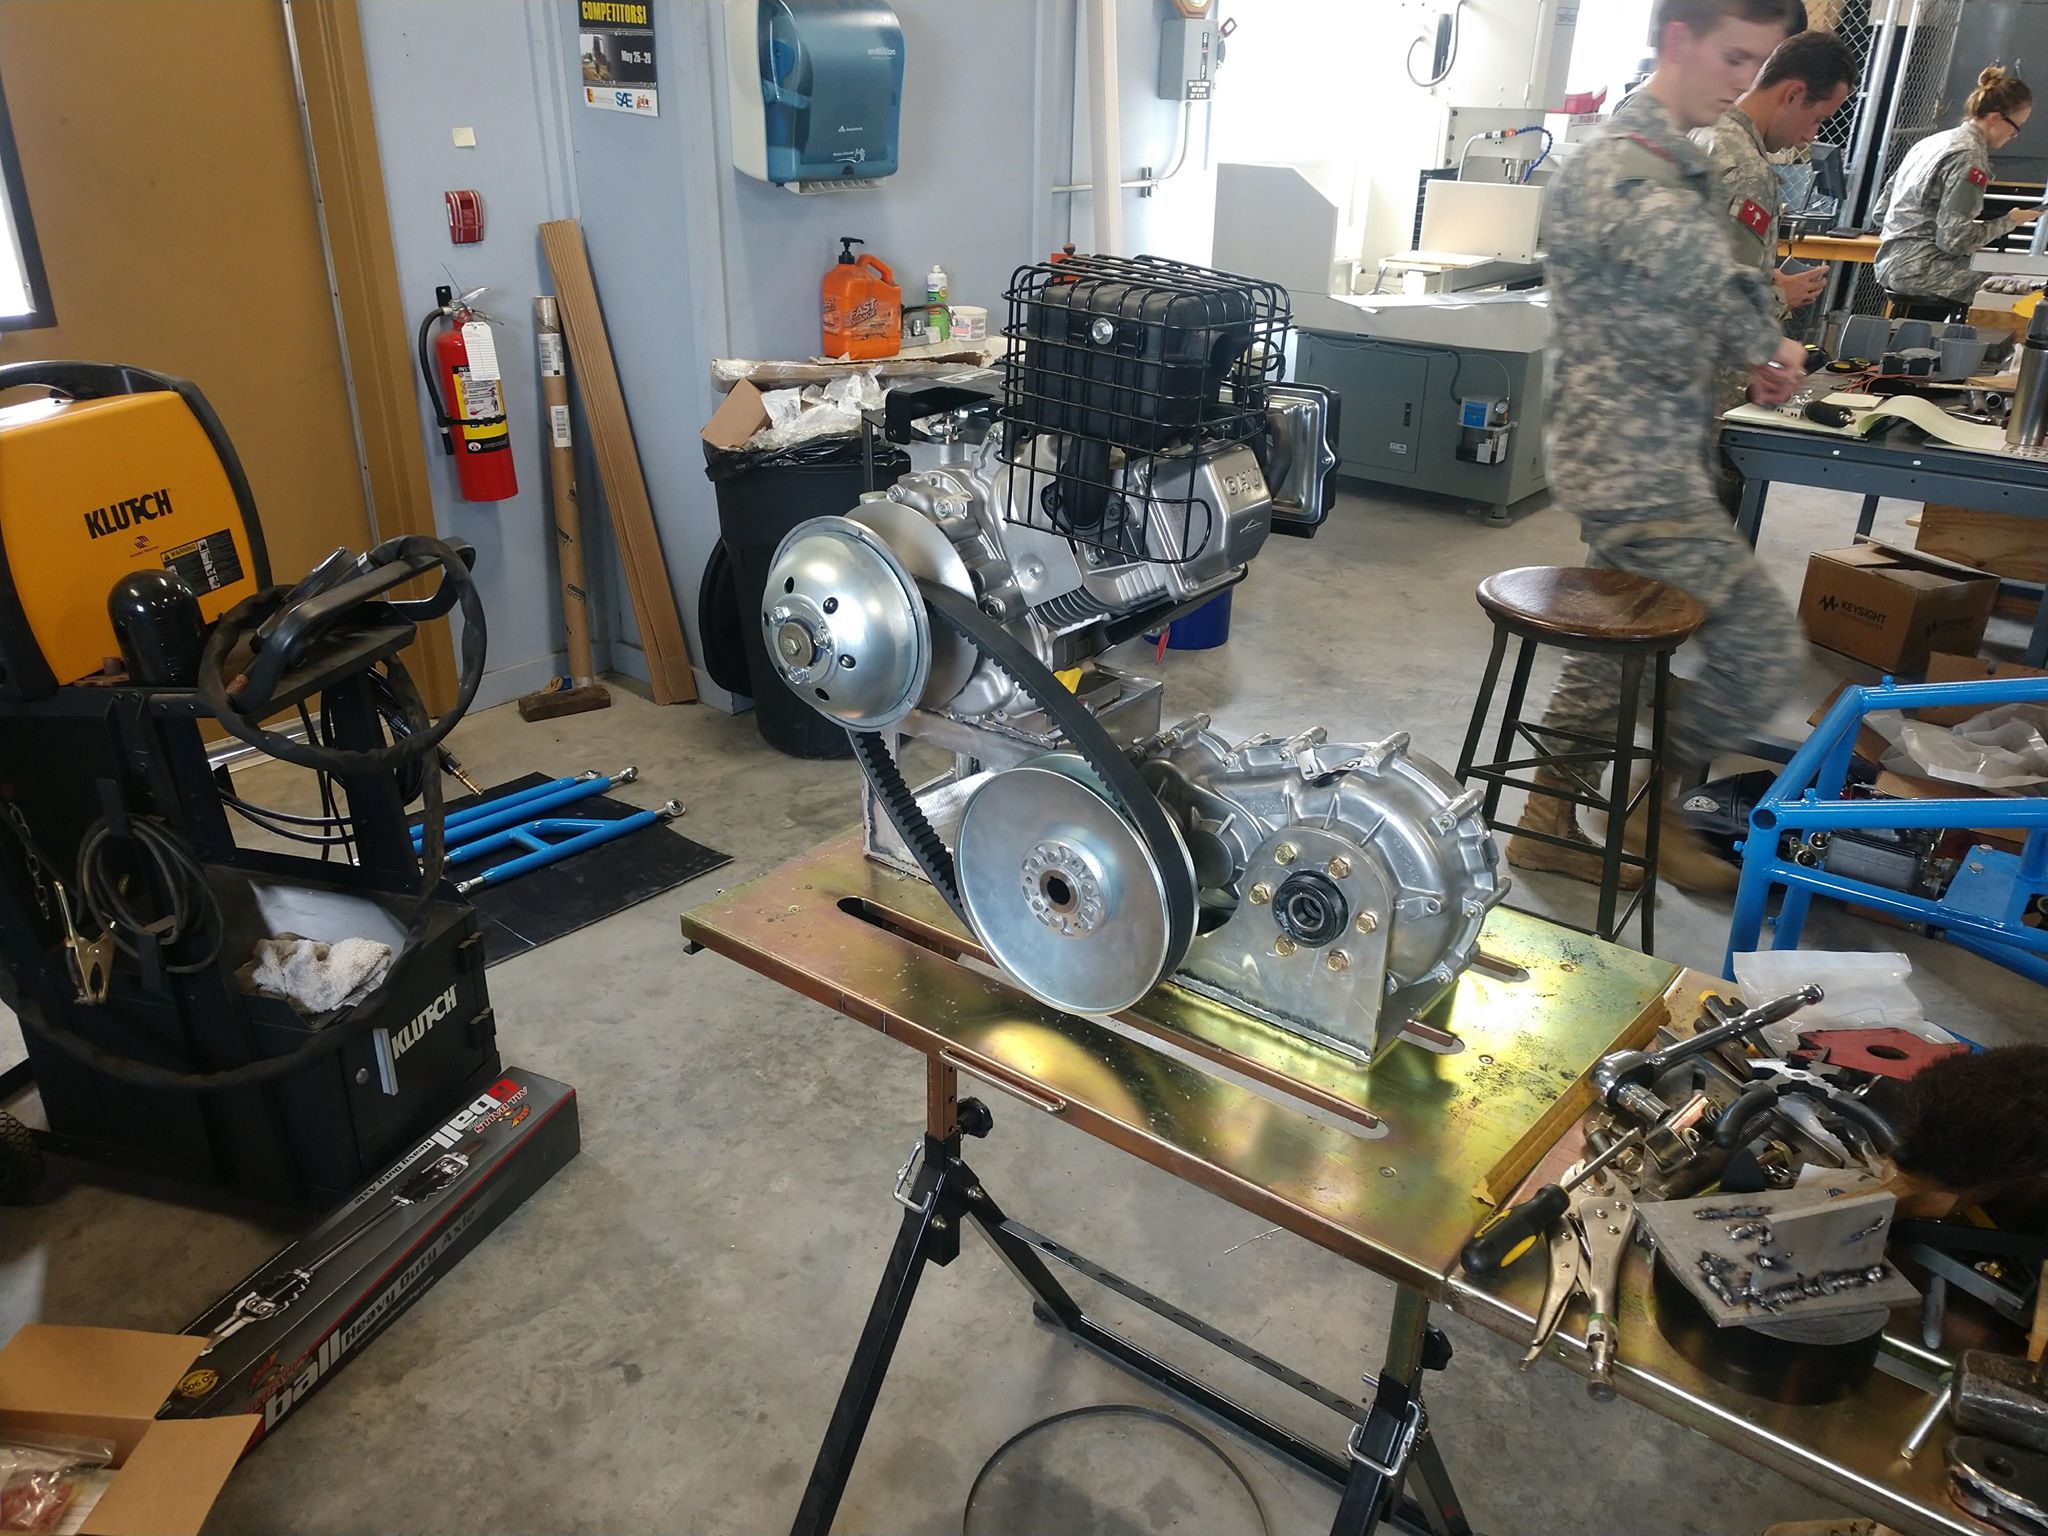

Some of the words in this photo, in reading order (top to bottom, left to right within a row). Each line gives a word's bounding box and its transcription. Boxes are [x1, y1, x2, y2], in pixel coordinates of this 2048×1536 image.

[582, 1, 647, 24] COMPETITORS!
[621, 50, 633, 64] May
[615, 92, 633, 108] SAE
[850, 297, 878, 316] FAST
[84, 488, 173, 539] KLUTCH
[171, 543, 197, 558] WARNING
[1840, 600, 1887, 625] KEYSIGHT
[391, 985, 457, 1060] KLUTCH
[507, 1086, 528, 1105] ALL
[401, 1140, 432, 1165] Heavy
[378, 1165, 402, 1185] Duty
[344, 1289, 396, 1346] Heavy
[400, 1247, 438, 1290] Duty
[260, 1327, 341, 1432] ball
